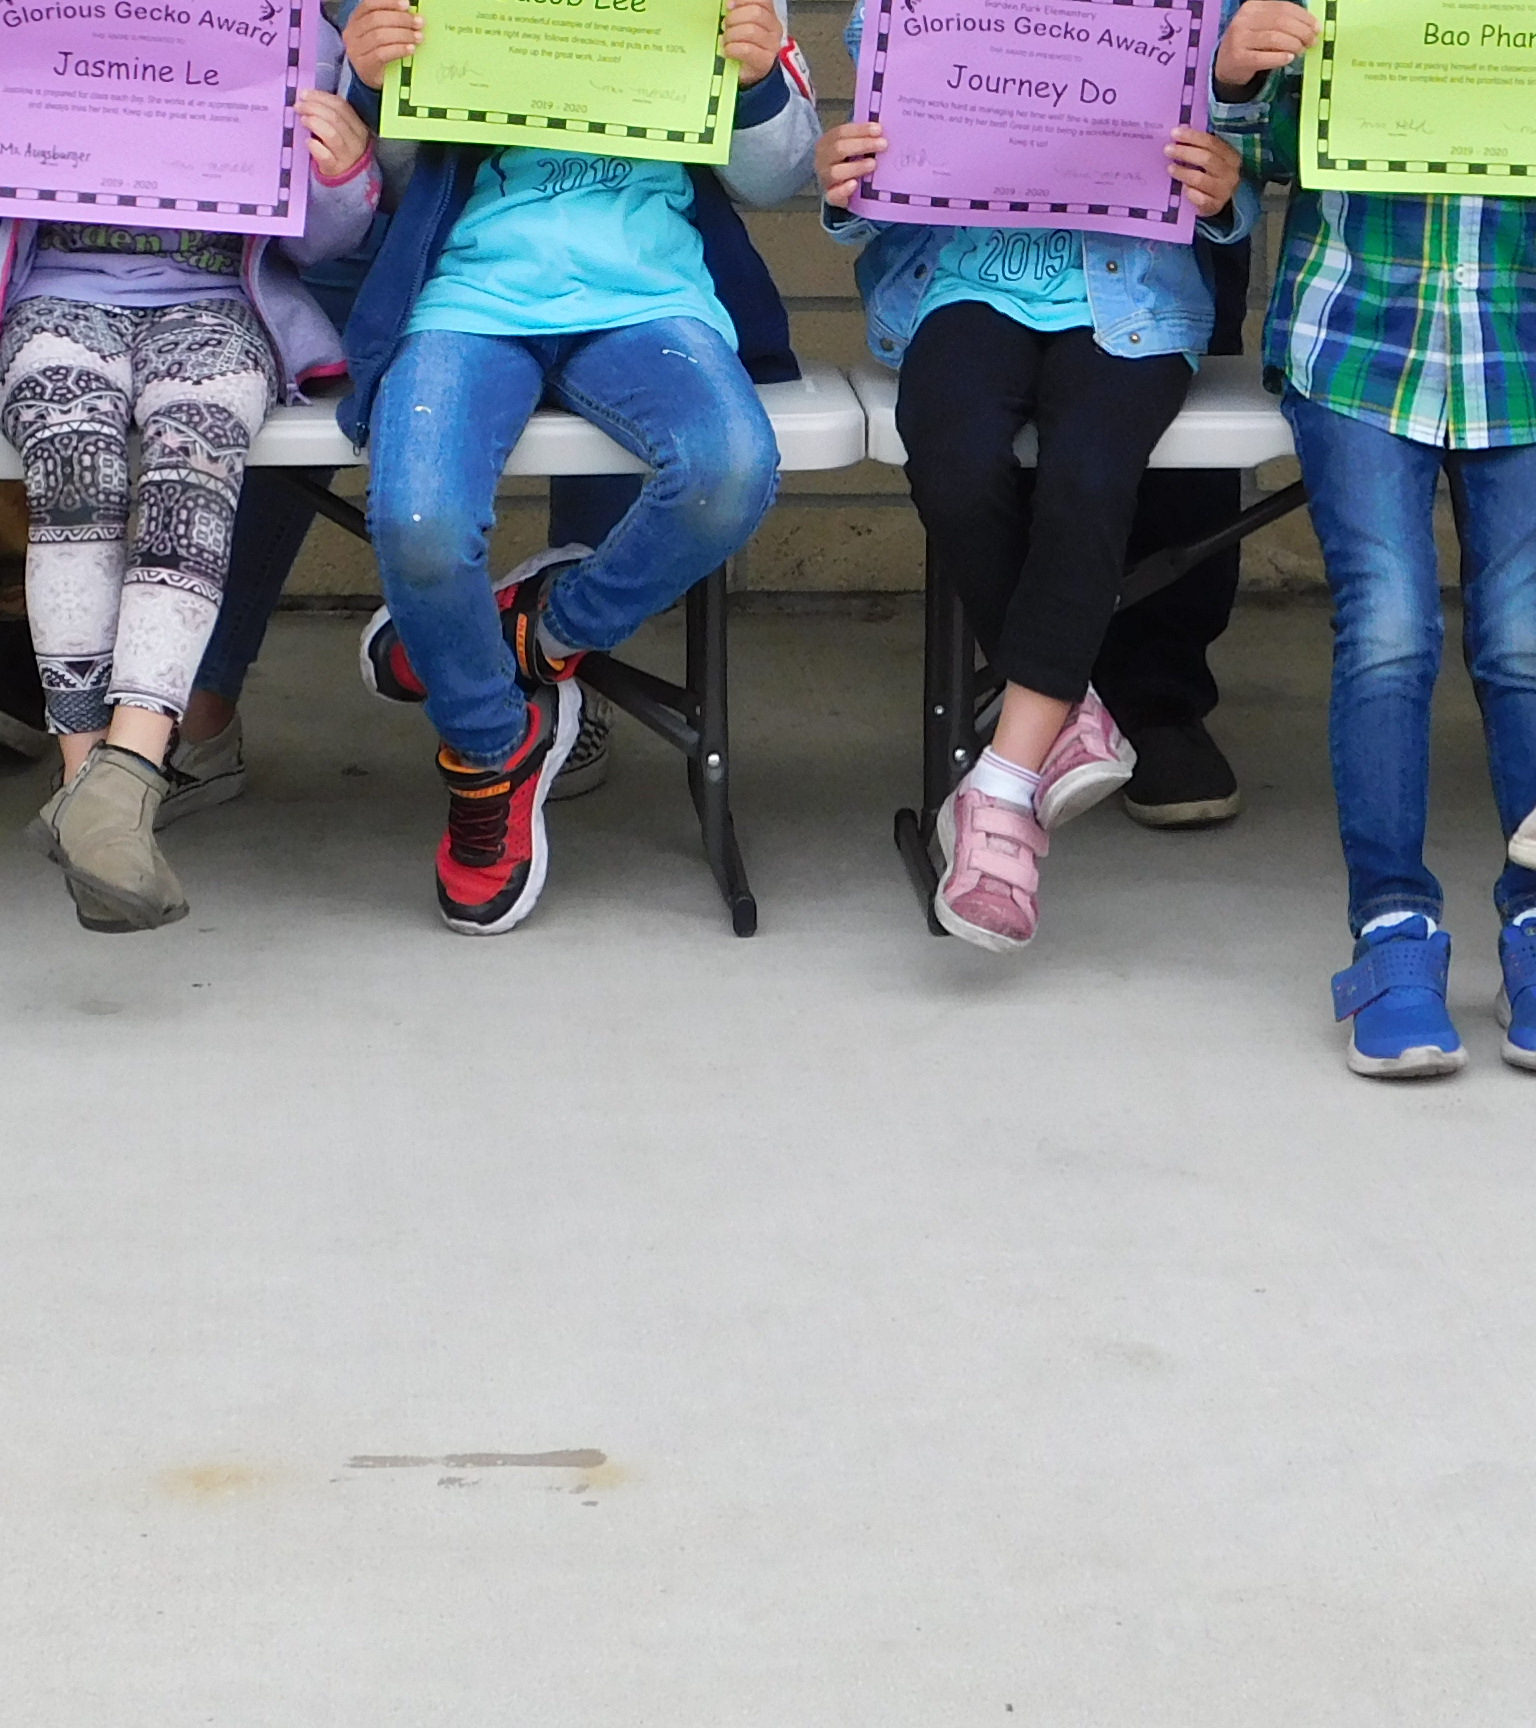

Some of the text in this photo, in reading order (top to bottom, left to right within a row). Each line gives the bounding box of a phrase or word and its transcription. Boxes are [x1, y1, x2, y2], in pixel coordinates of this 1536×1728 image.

[3, 1, 277, 47] Glorious Gecko Award
[904, 13, 1175, 66] Glorious Gecko Award
[1424, 23, 1470, 46] Bao
[53, 51, 219, 86] Jasmine Le
[947, 64, 1117, 107] Journey Do
[979, 229, 1072, 282] 2019
